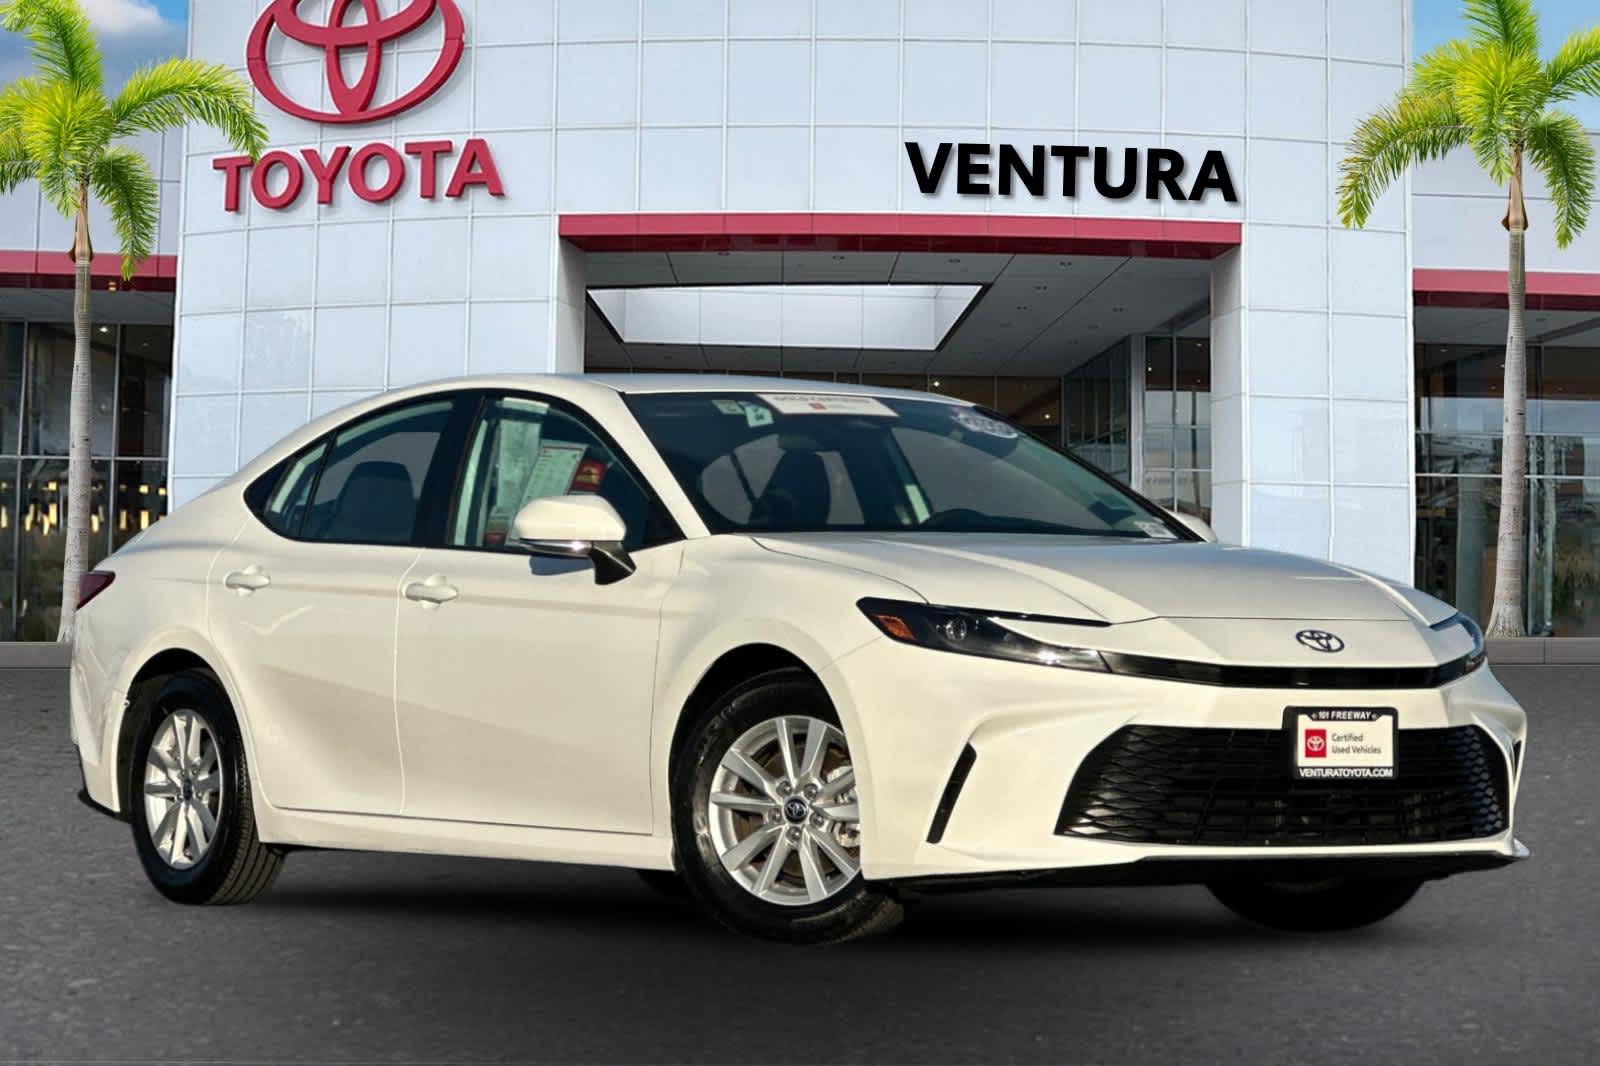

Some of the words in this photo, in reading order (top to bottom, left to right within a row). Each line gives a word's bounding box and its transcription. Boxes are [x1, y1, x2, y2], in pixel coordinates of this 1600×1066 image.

[213, 139, 505, 212] TOYOTA
[905, 142, 1238, 202] VENTURA
[1318, 711, 1330, 719] 101
[1331, 711, 1371, 719] FREEWAY
[1332, 733, 1363, 742] Certified
[1332, 746, 1350, 754] Used
[1352, 745, 1381, 754] Vehicles
[1300, 768, 1393, 777] VENTURATOYOTA.COM
